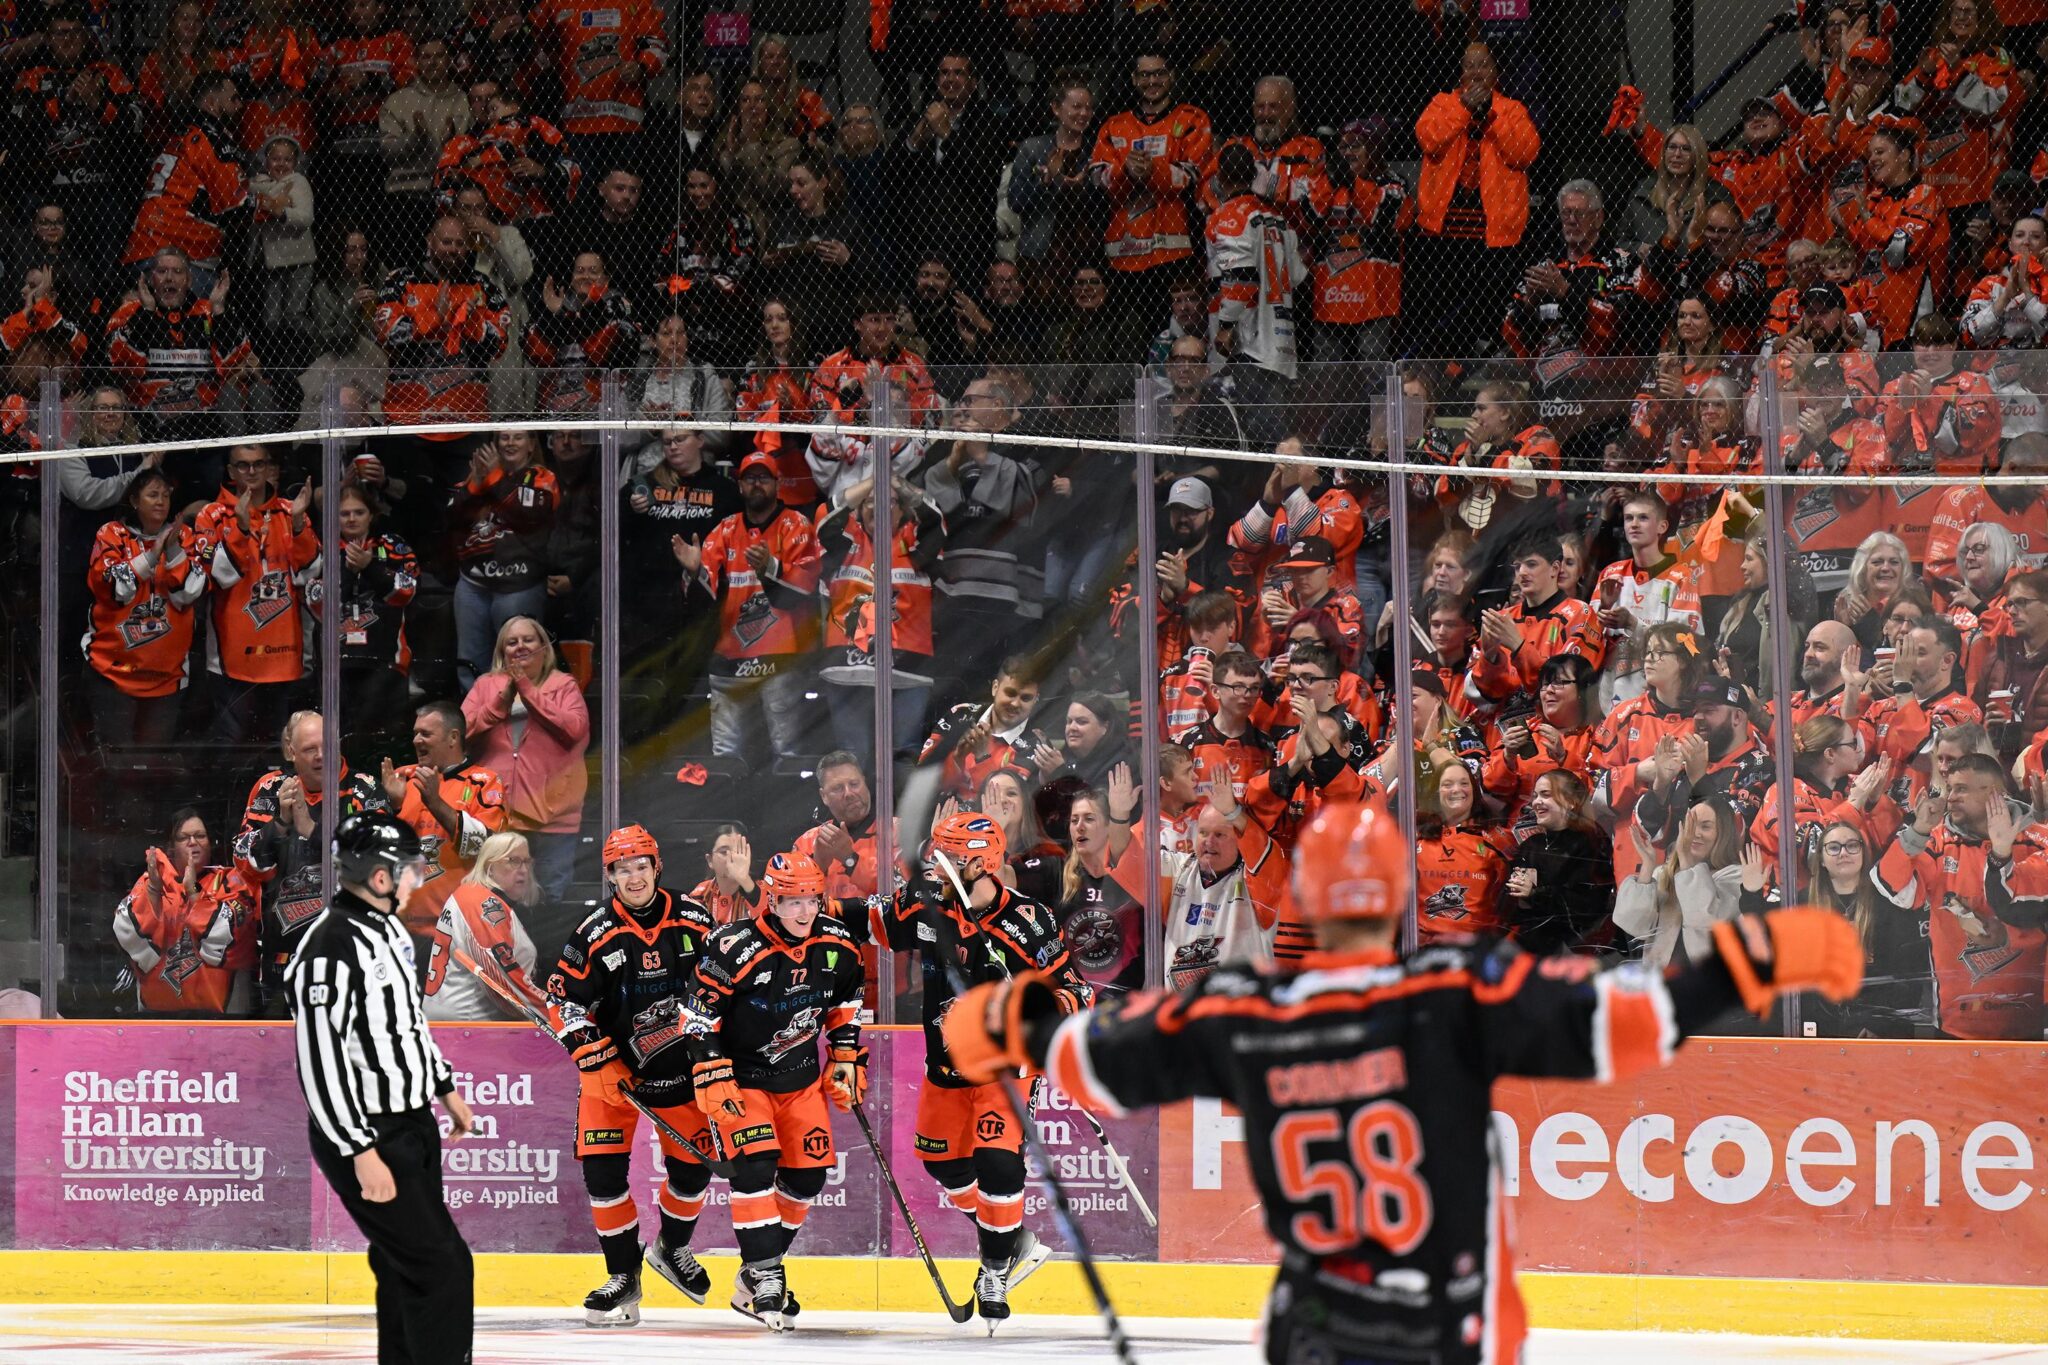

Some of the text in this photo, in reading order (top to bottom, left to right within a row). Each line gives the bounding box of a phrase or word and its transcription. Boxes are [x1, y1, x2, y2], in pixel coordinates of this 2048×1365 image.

[1493, 0, 1516, 15] 112
[716, 27, 738, 42] 112
[1323, 285, 1367, 304] Coors
[1539, 400, 1584, 417] Coors
[647, 505, 714, 520] CHAMPIONS
[483, 560, 528, 577] Coors
[734, 660, 776, 678] Coors
[1086, 887, 1103, 902] 31
[680, 909, 711, 924] ogilvie
[1068, 910, 1109, 940] STEELERS
[587, 919, 613, 943] ogilvie
[822, 925, 850, 938] ogilvie
[1001, 918, 1028, 945] ogilvie
[642, 950, 661, 970] 63
[735, 940, 763, 965] ogilvie
[546, 973, 566, 998] 63
[791, 968, 808, 985] 77
[308, 984, 329, 1005] 80
[64, 1069, 240, 1103] Sheffield
[61, 1105, 204, 1137] Hallam
[977, 1119, 1006, 1136] KTR
[747, 1129, 759, 1138] MF
[803, 1135, 830, 1153] KTR
[930, 1140, 946, 1149] Hire
[1193, 1095, 2035, 1211] Hecoene
[61, 1137, 266, 1181] University
[1271, 1099, 1434, 1256] 58
[64, 1183, 265, 1207] Knowledge Applied
[477, 1185, 559, 1209] Applied
[1064, 1193, 1129, 1216] pplied
